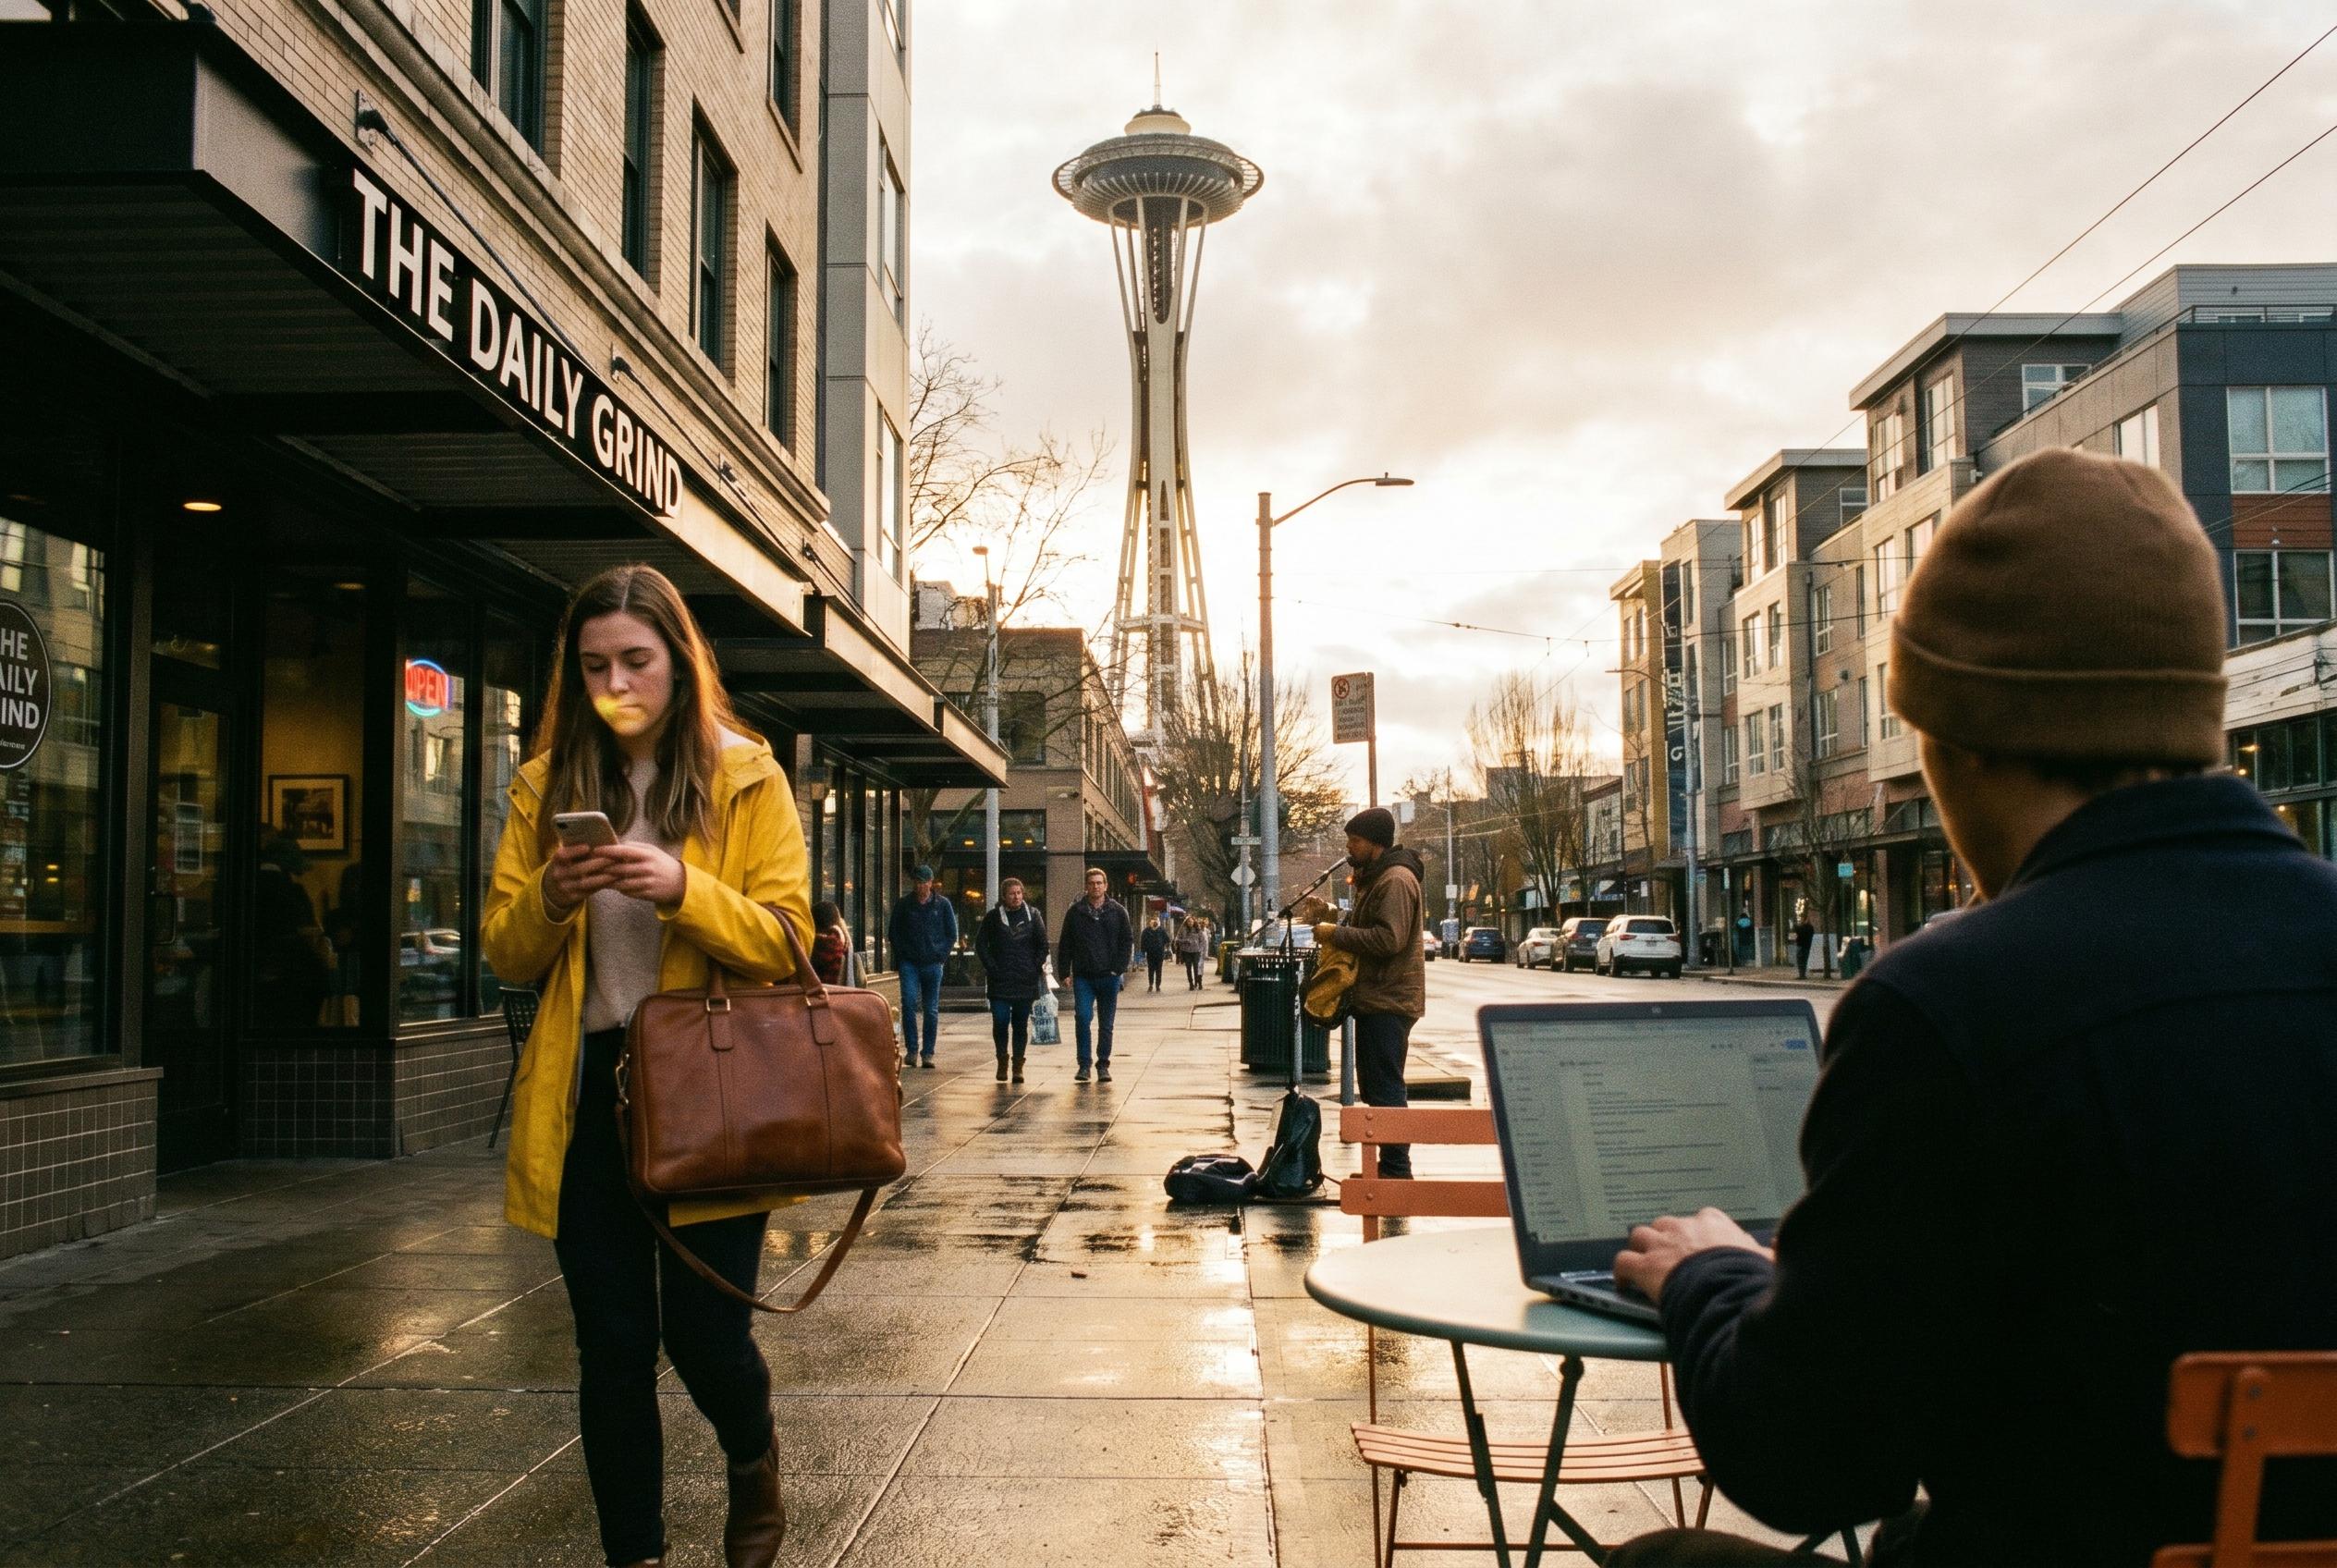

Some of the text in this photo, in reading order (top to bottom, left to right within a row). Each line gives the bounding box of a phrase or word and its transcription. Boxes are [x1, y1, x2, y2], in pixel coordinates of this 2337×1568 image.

[354, 167, 682, 518] THE DAILY GRIND
[0, 628, 29, 661] HE
[406, 666, 448, 710] OPEN
[1, 697, 40, 729] IND
